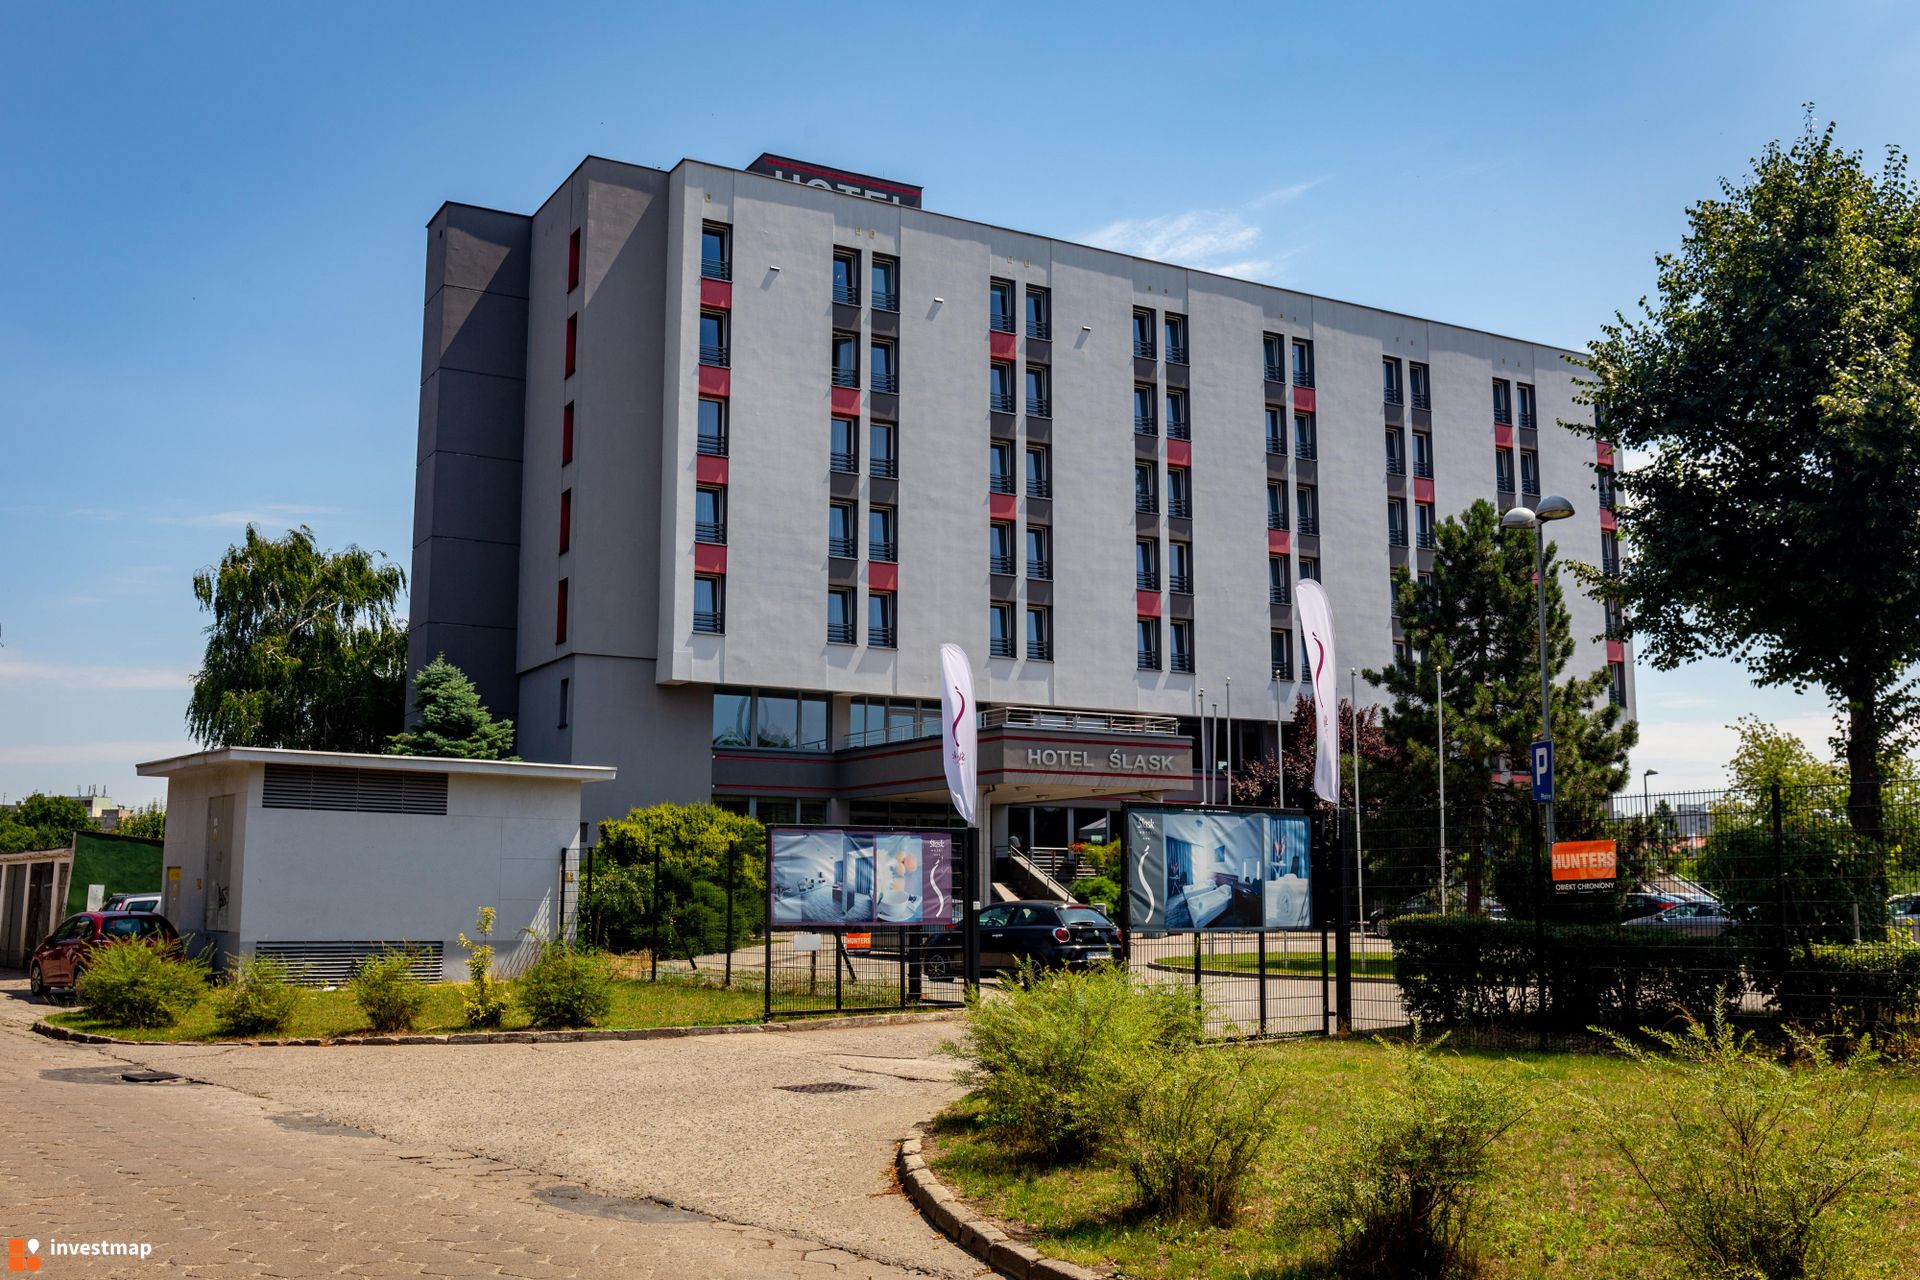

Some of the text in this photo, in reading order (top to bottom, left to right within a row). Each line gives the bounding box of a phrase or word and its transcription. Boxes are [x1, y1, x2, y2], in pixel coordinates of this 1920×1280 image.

[1027, 748, 1174, 773] HOTEL ŚLĄSK
[1535, 747, 1548, 786] P
[1552, 851, 1616, 870] HUNTERS
[1555, 882, 1615, 891] OBIEKT CHRONIONY
